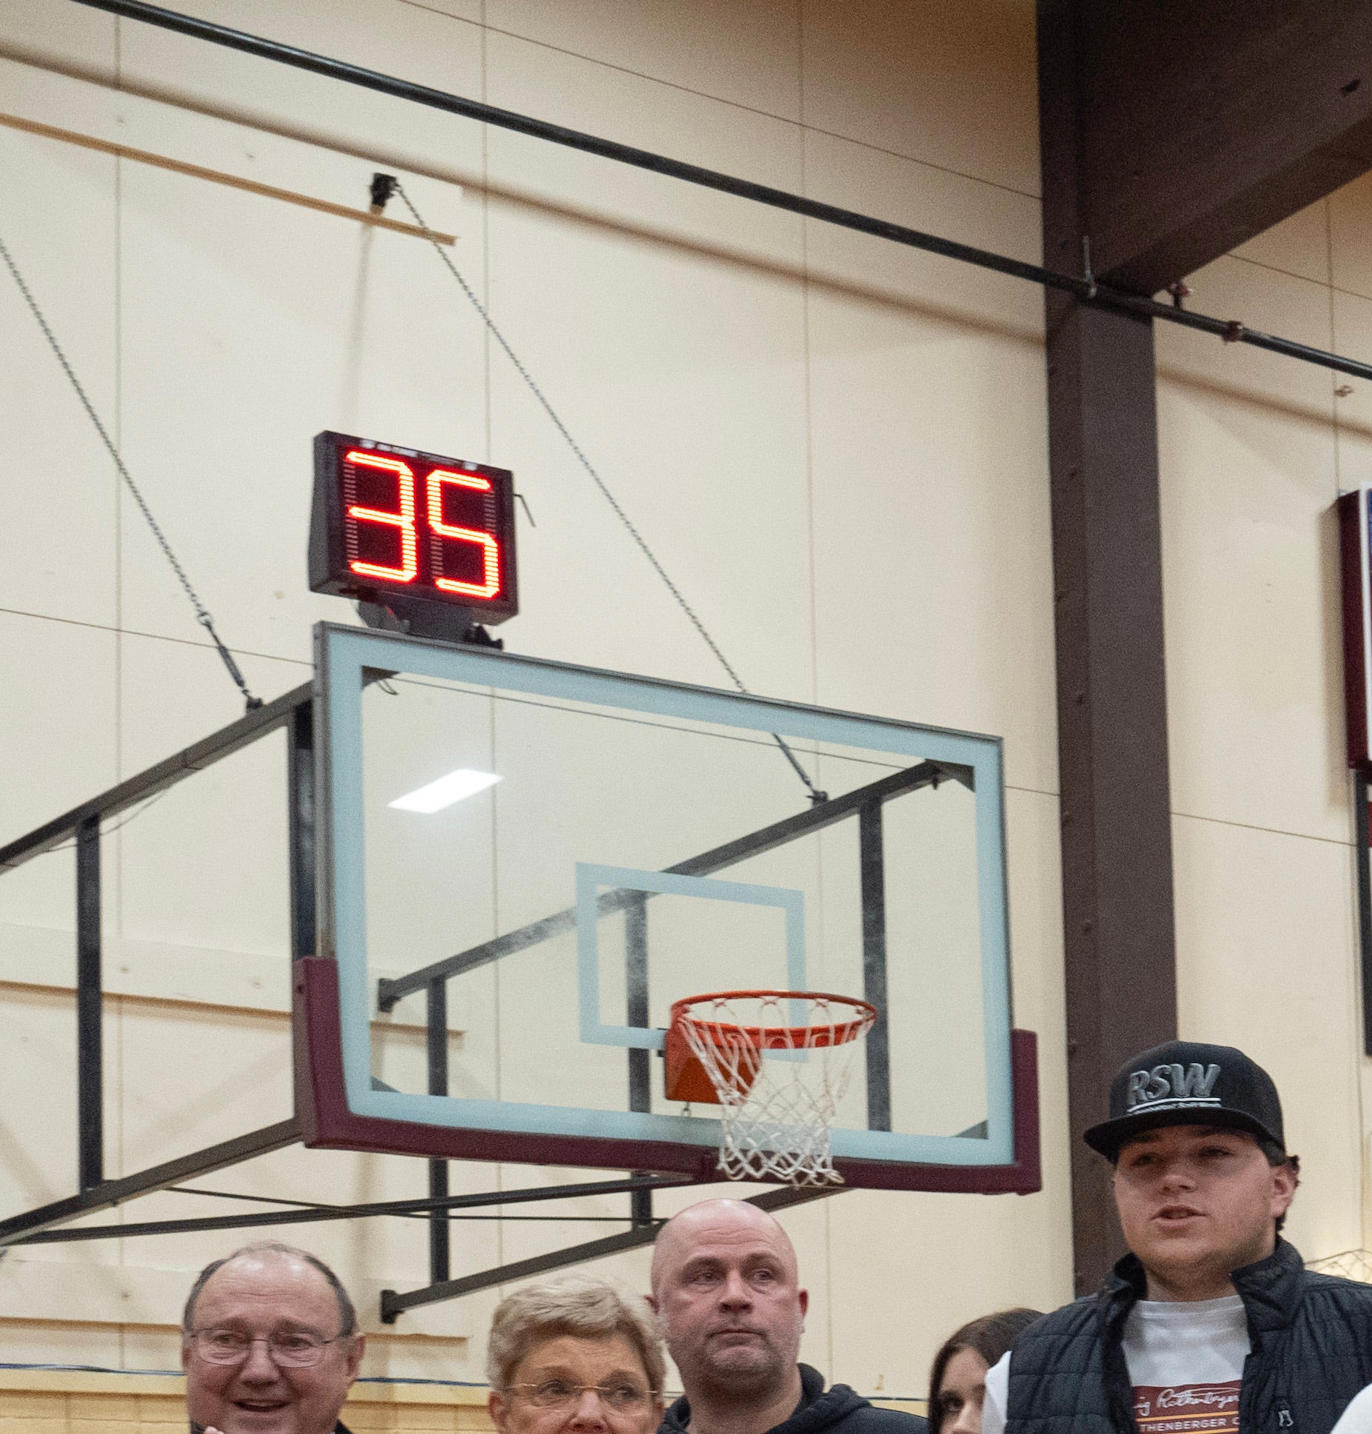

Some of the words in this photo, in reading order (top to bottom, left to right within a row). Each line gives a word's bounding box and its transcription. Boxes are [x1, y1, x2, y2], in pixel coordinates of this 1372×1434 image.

[346, 451, 500, 598] 35
[1128, 1063, 1221, 1105] RSW
[1140, 1418, 1227, 1432] THENBERGER
